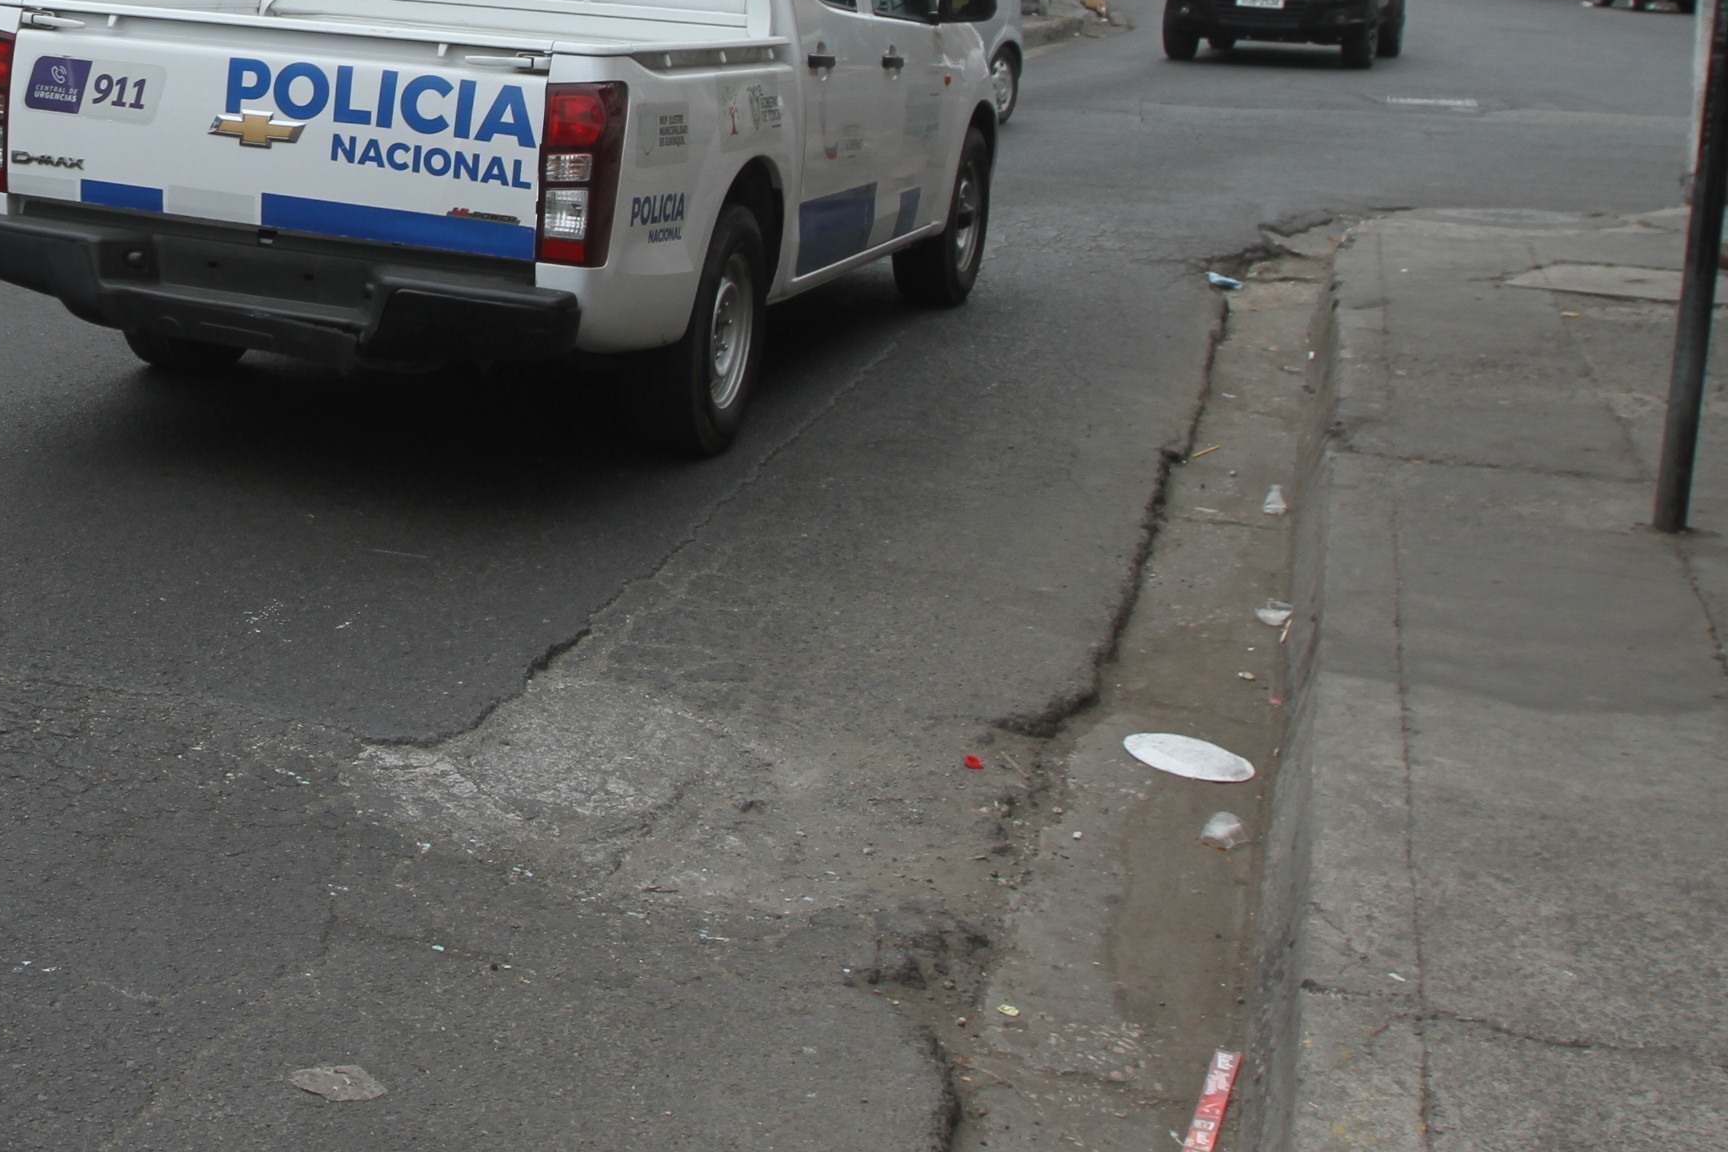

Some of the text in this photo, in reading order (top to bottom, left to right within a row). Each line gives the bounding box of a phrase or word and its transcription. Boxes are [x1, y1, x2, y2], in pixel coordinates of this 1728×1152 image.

[33, 91, 78, 103] URGENCIAS
[35, 84, 79, 95] CENTRAL DE
[91, 73, 147, 110] 911
[224, 56, 537, 149] POLICIA
[11, 150, 85, 171] D-MAX
[330, 133, 532, 190] NACIONAL
[629, 192, 685, 228] POLICIA
[647, 226, 683, 244] NACIONAL
